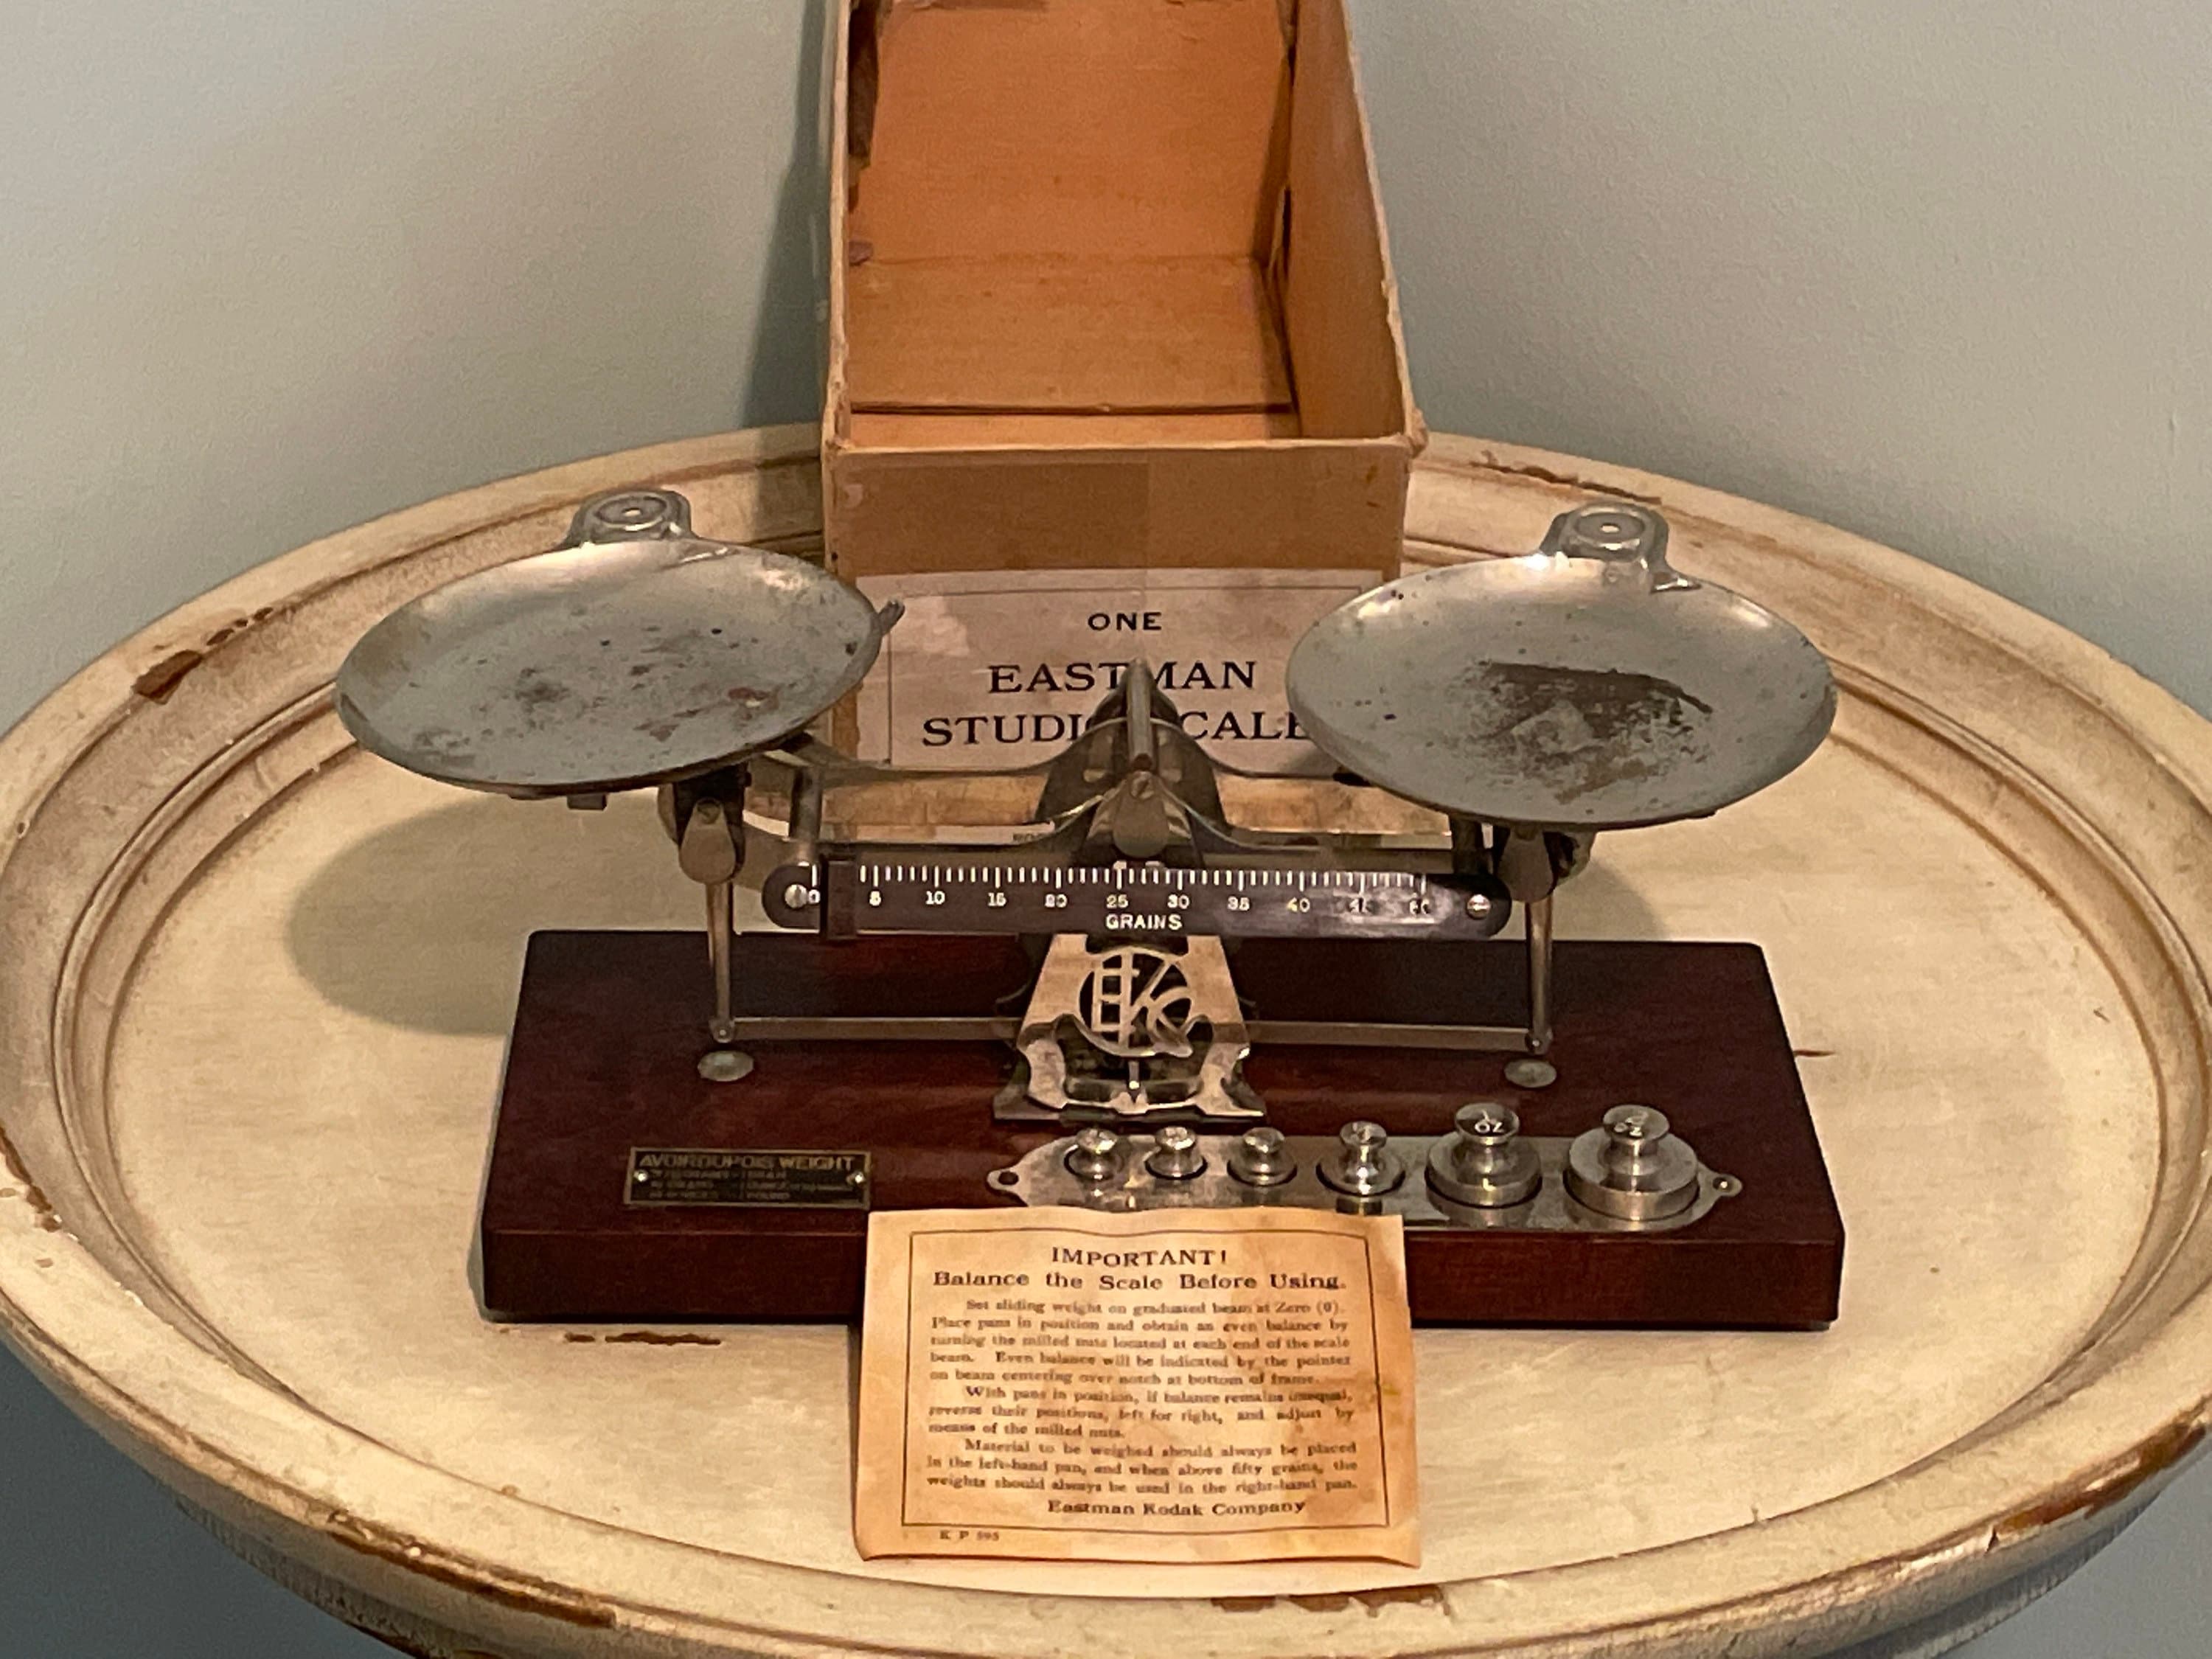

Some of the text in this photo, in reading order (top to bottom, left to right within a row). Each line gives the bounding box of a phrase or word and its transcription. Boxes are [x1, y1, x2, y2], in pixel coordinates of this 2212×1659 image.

[1088, 612, 1163, 631] ONE
[922, 714, 1094, 746] STUDI
[926, 891, 945, 905] 10
[988, 893, 1006, 906] 15
[1045, 894, 1068, 908] 20
[1107, 895, 1129, 909] 25
[1167, 894, 1189, 909] 30
[1228, 897, 1250, 911] 35
[1287, 898, 1310, 912] 40
[1106, 914, 1182, 930] GRAINS
[779, 1155, 855, 1171] WEIGHT
[1052, 1246, 1226, 1266] IMPORTANT!
[933, 1271, 1346, 1290] Balance the Scale Before Using.
[967, 1300, 989, 1310] Set
[996, 1299, 1045, 1313] sliding
[1052, 1301, 1102, 1315] weight
[1108, 1304, 1127, 1314] on
[1276, 1302, 1311, 1312] Zero
[932, 1316, 1348, 1332] Place pans in position and obtain an even balance by
[992, 1335, 1015, 1345] the
[1022, 1335, 1069, 1346] milled
[1113, 1336, 1166, 1349] located
[1173, 1340, 1186, 1349] at
[1193, 1338, 1227, 1349] each
[1233, 1338, 1259, 1349] end
[1267, 1338, 1281, 1349] of
[1286, 1338, 1309, 1348] the
[1314, 1338, 1349, 1348] scale
[995, 1351, 1034, 1363] Even
[1040, 1352, 1096, 1364] balance
[1102, 1356, 1130, 1366] will
[1137, 1355, 1153, 1367] be
[1161, 1355, 1228, 1367] indicated
[1237, 1355, 1255, 1369] by
[1265, 1355, 1287, 1366] the
[1296, 1354, 1351, 1368] pointer
[930, 1371, 948, 1380] on
[956, 1368, 995, 1380] beam
[1001, 1368, 1073, 1385] centering
[1079, 1374, 1113, 1383] over
[1168, 1374, 1180, 1385] at
[1189, 1374, 1243, 1385] bottom
[1249, 1373, 1265, 1384] of
[966, 1385, 1006, 1398] With
[1013, 1389, 1047, 1401] pans
[1053, 1388, 1067, 1399] in
[1147, 1391, 1158, 1402] if
[1164, 1391, 1220, 1403] balance
[1224, 1392, 1283, 1404] remains
[992, 1405, 1029, 1416] their
[1119, 1408, 1144, 1419] left
[1150, 1409, 1172, 1422] for
[1237, 1409, 1264, 1420] and
[1276, 1408, 1321, 1421] adjust
[1335, 1407, 1354, 1422] by
[982, 1422, 998, 1433] of
[1004, 1423, 1028, 1434] the
[1035, 1424, 1082, 1436] milled
[965, 1439, 1029, 1452] Material
[1038, 1444, 1055, 1453] to
[1063, 1442, 1081, 1453] be
[1162, 1445, 1212, 1457] should
[1221, 1445, 1272, 1458] always
[1281, 1444, 1297, 1455] be
[1307, 1441, 1356, 1455] placed
[949, 1457, 973, 1468] the
[1093, 1463, 1121, 1475] and
[1129, 1464, 1169, 1475] when
[1178, 1464, 1222, 1476] above
[1232, 1462, 1262, 1476] fifty
[1333, 1459, 1357, 1471] the
[927, 1475, 986, 1489] weights
[995, 1476, 1044, 1490] should
[1051, 1478, 1102, 1494] always
[1109, 1481, 1126, 1492] be
[1135, 1483, 1169, 1494] used
[1179, 1482, 1194, 1494] in
[1203, 1482, 1227, 1493] the
[1048, 1500, 1306, 1516] Eastman Kodak Company
